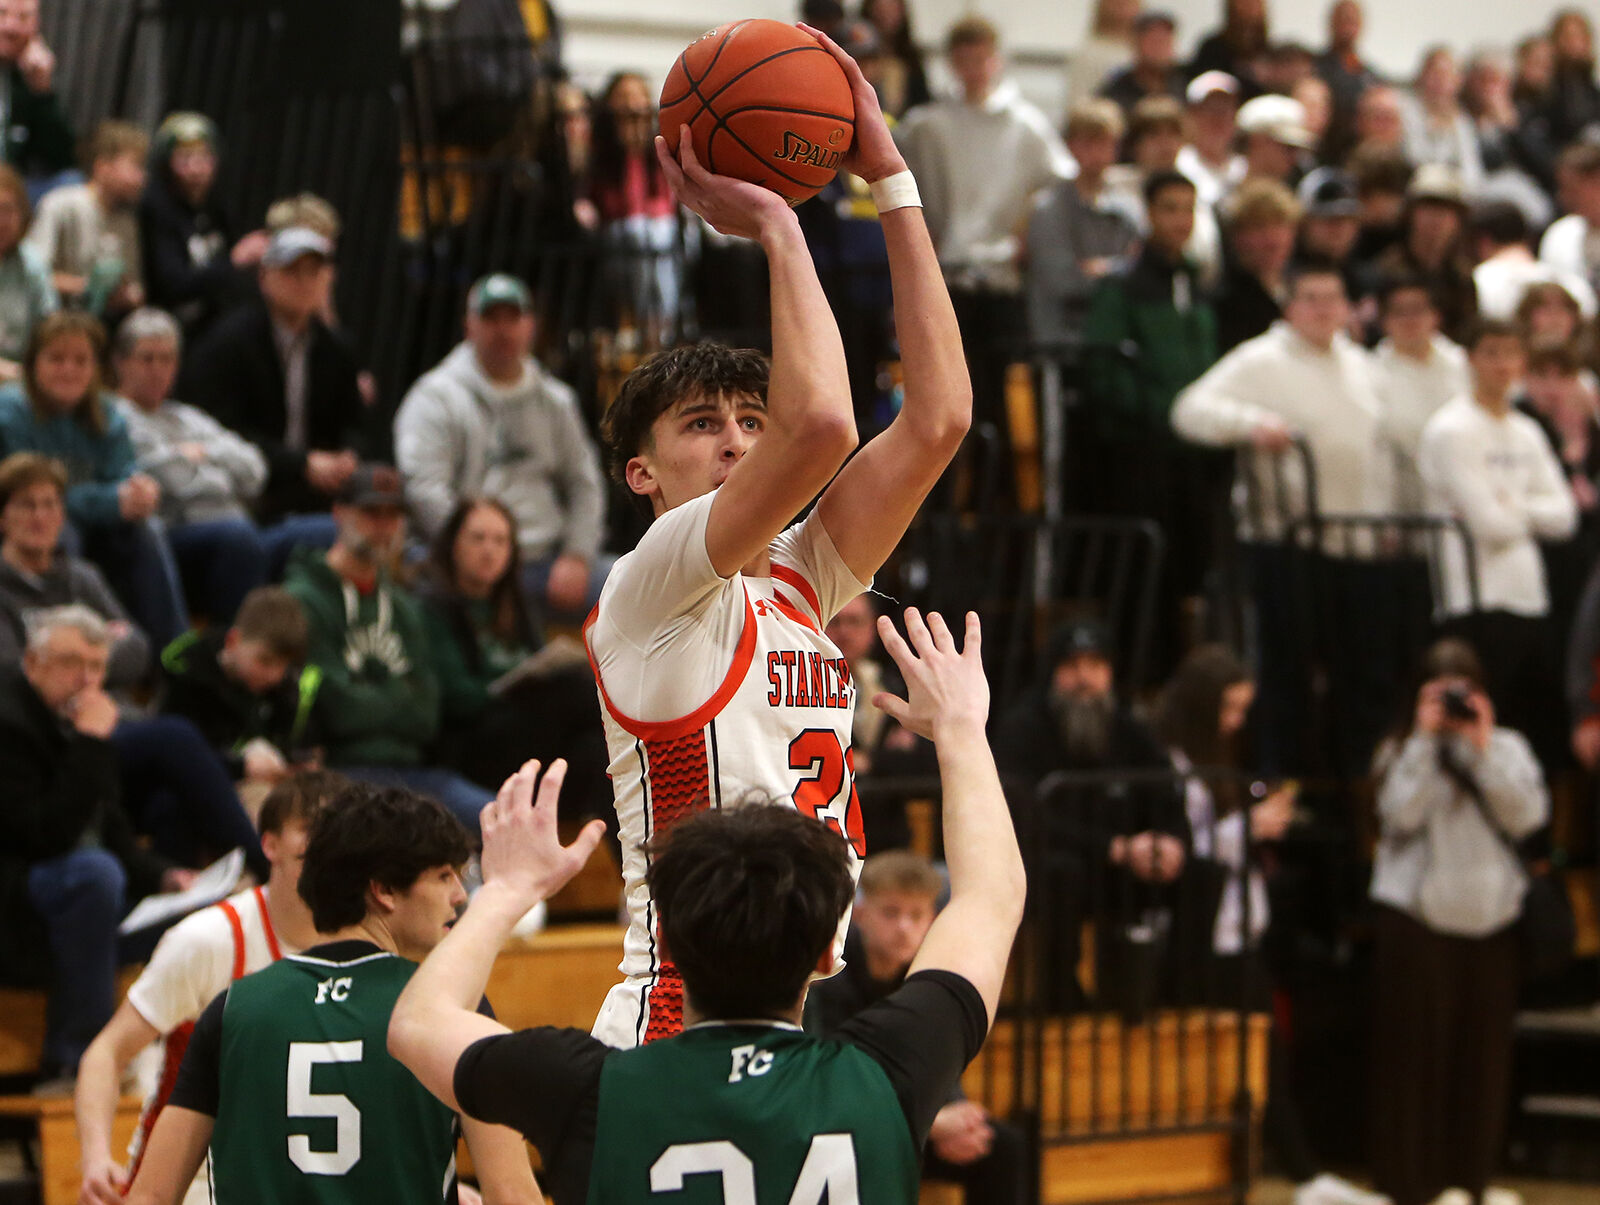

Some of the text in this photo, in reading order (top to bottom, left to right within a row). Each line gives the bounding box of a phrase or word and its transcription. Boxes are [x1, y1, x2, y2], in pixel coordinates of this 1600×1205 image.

[314, 977, 352, 1004] FC
[728, 1044, 774, 1083] FC
[286, 1039, 363, 1176] 5
